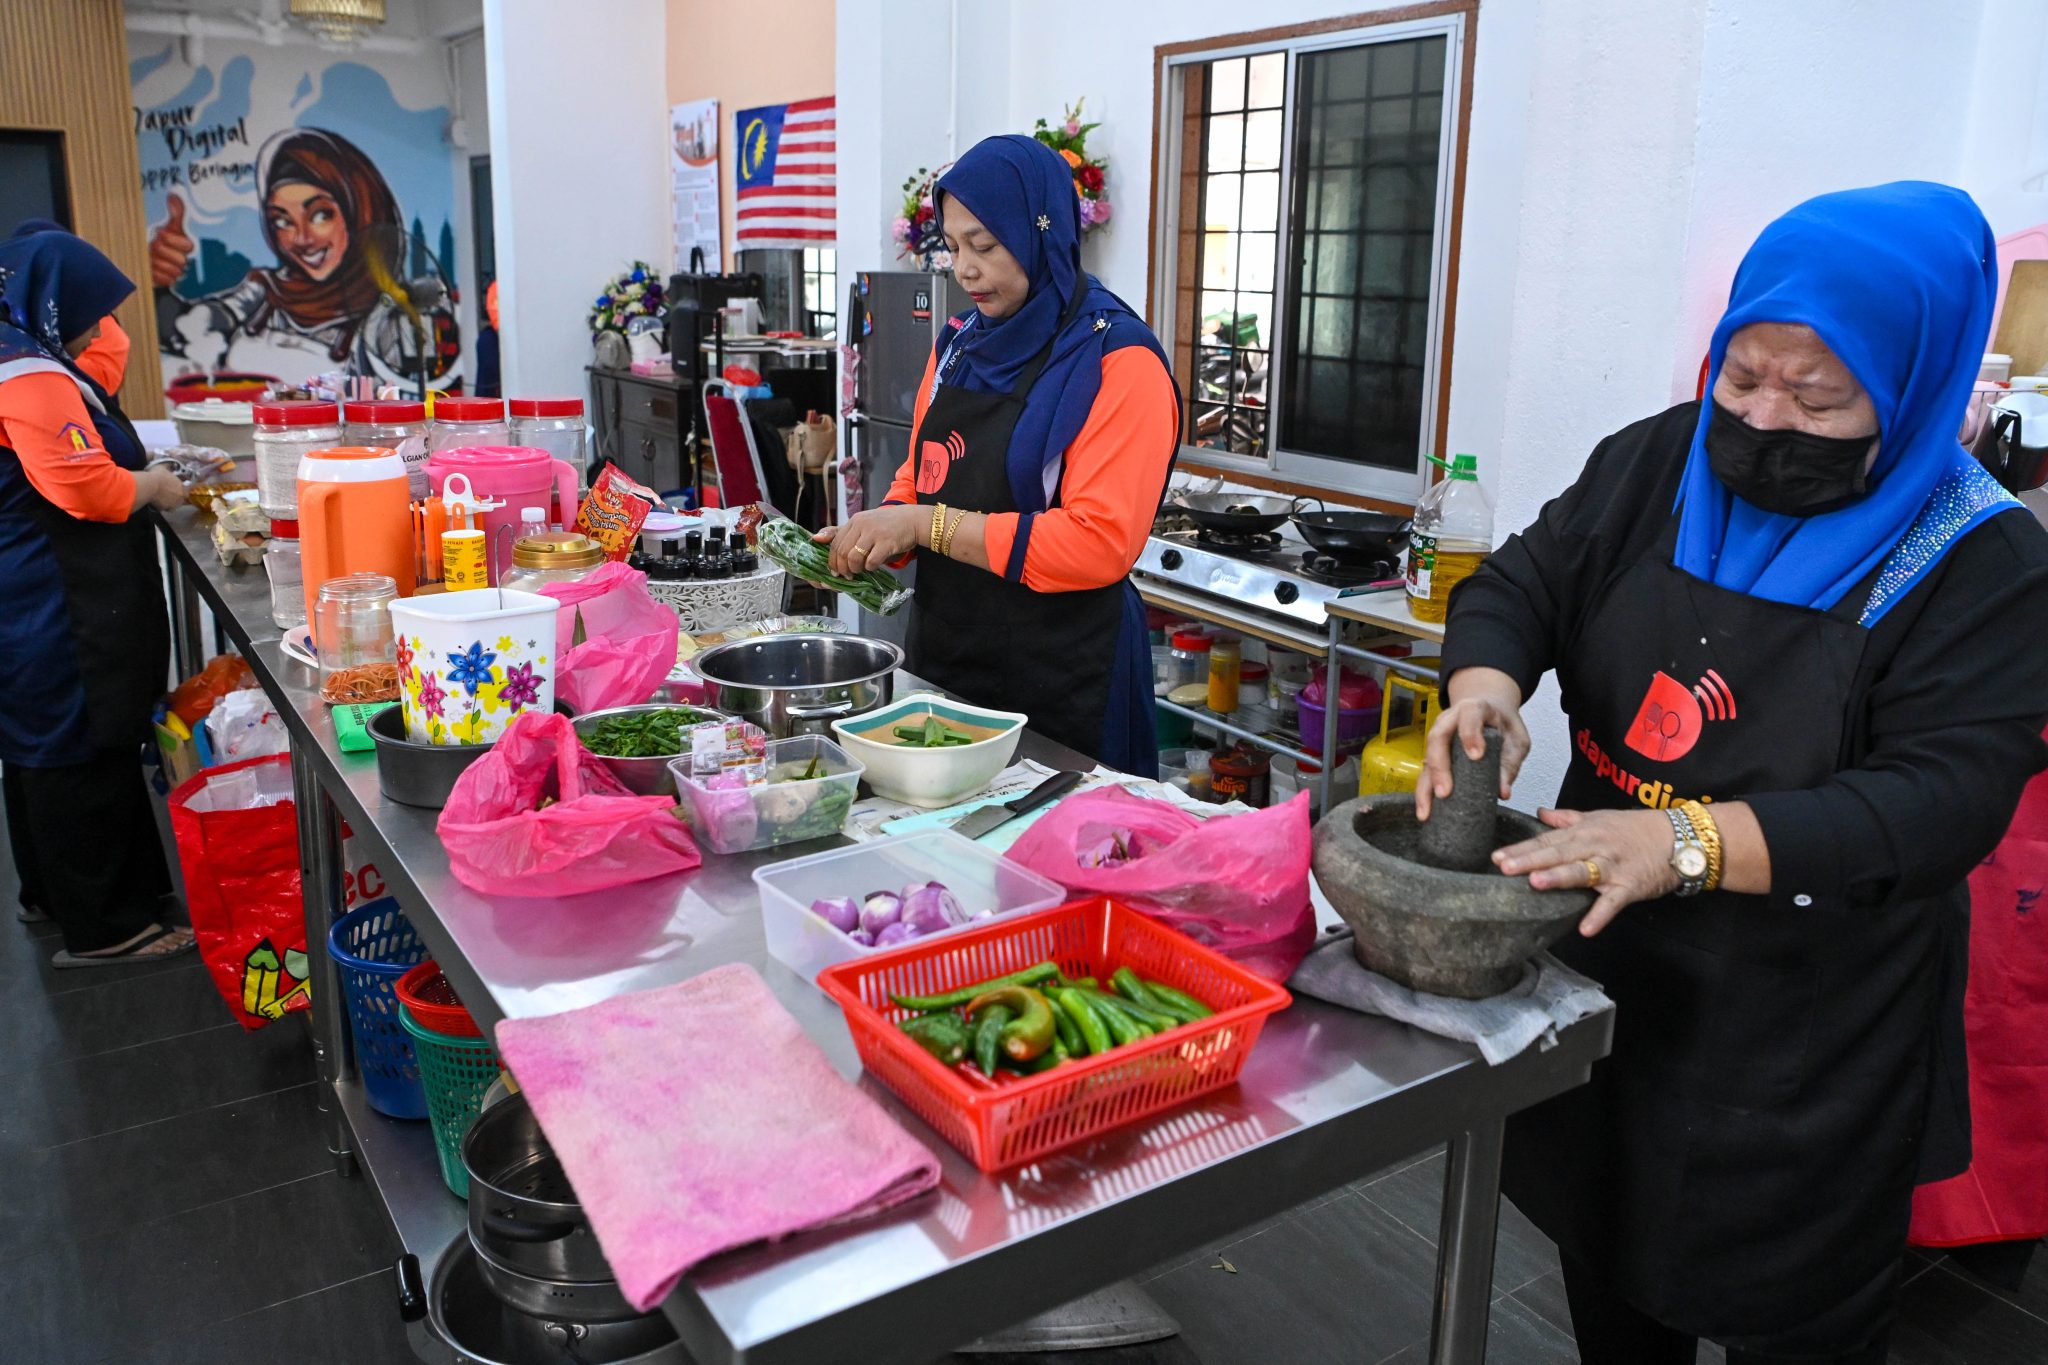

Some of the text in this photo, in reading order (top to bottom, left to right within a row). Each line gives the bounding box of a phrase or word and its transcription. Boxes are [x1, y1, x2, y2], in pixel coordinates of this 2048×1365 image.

[163, 117, 249, 160] Digital
[915, 295, 928, 309] 10
[402, 454, 422, 463] LGIAN
[1577, 728, 1713, 811] dapurdi
